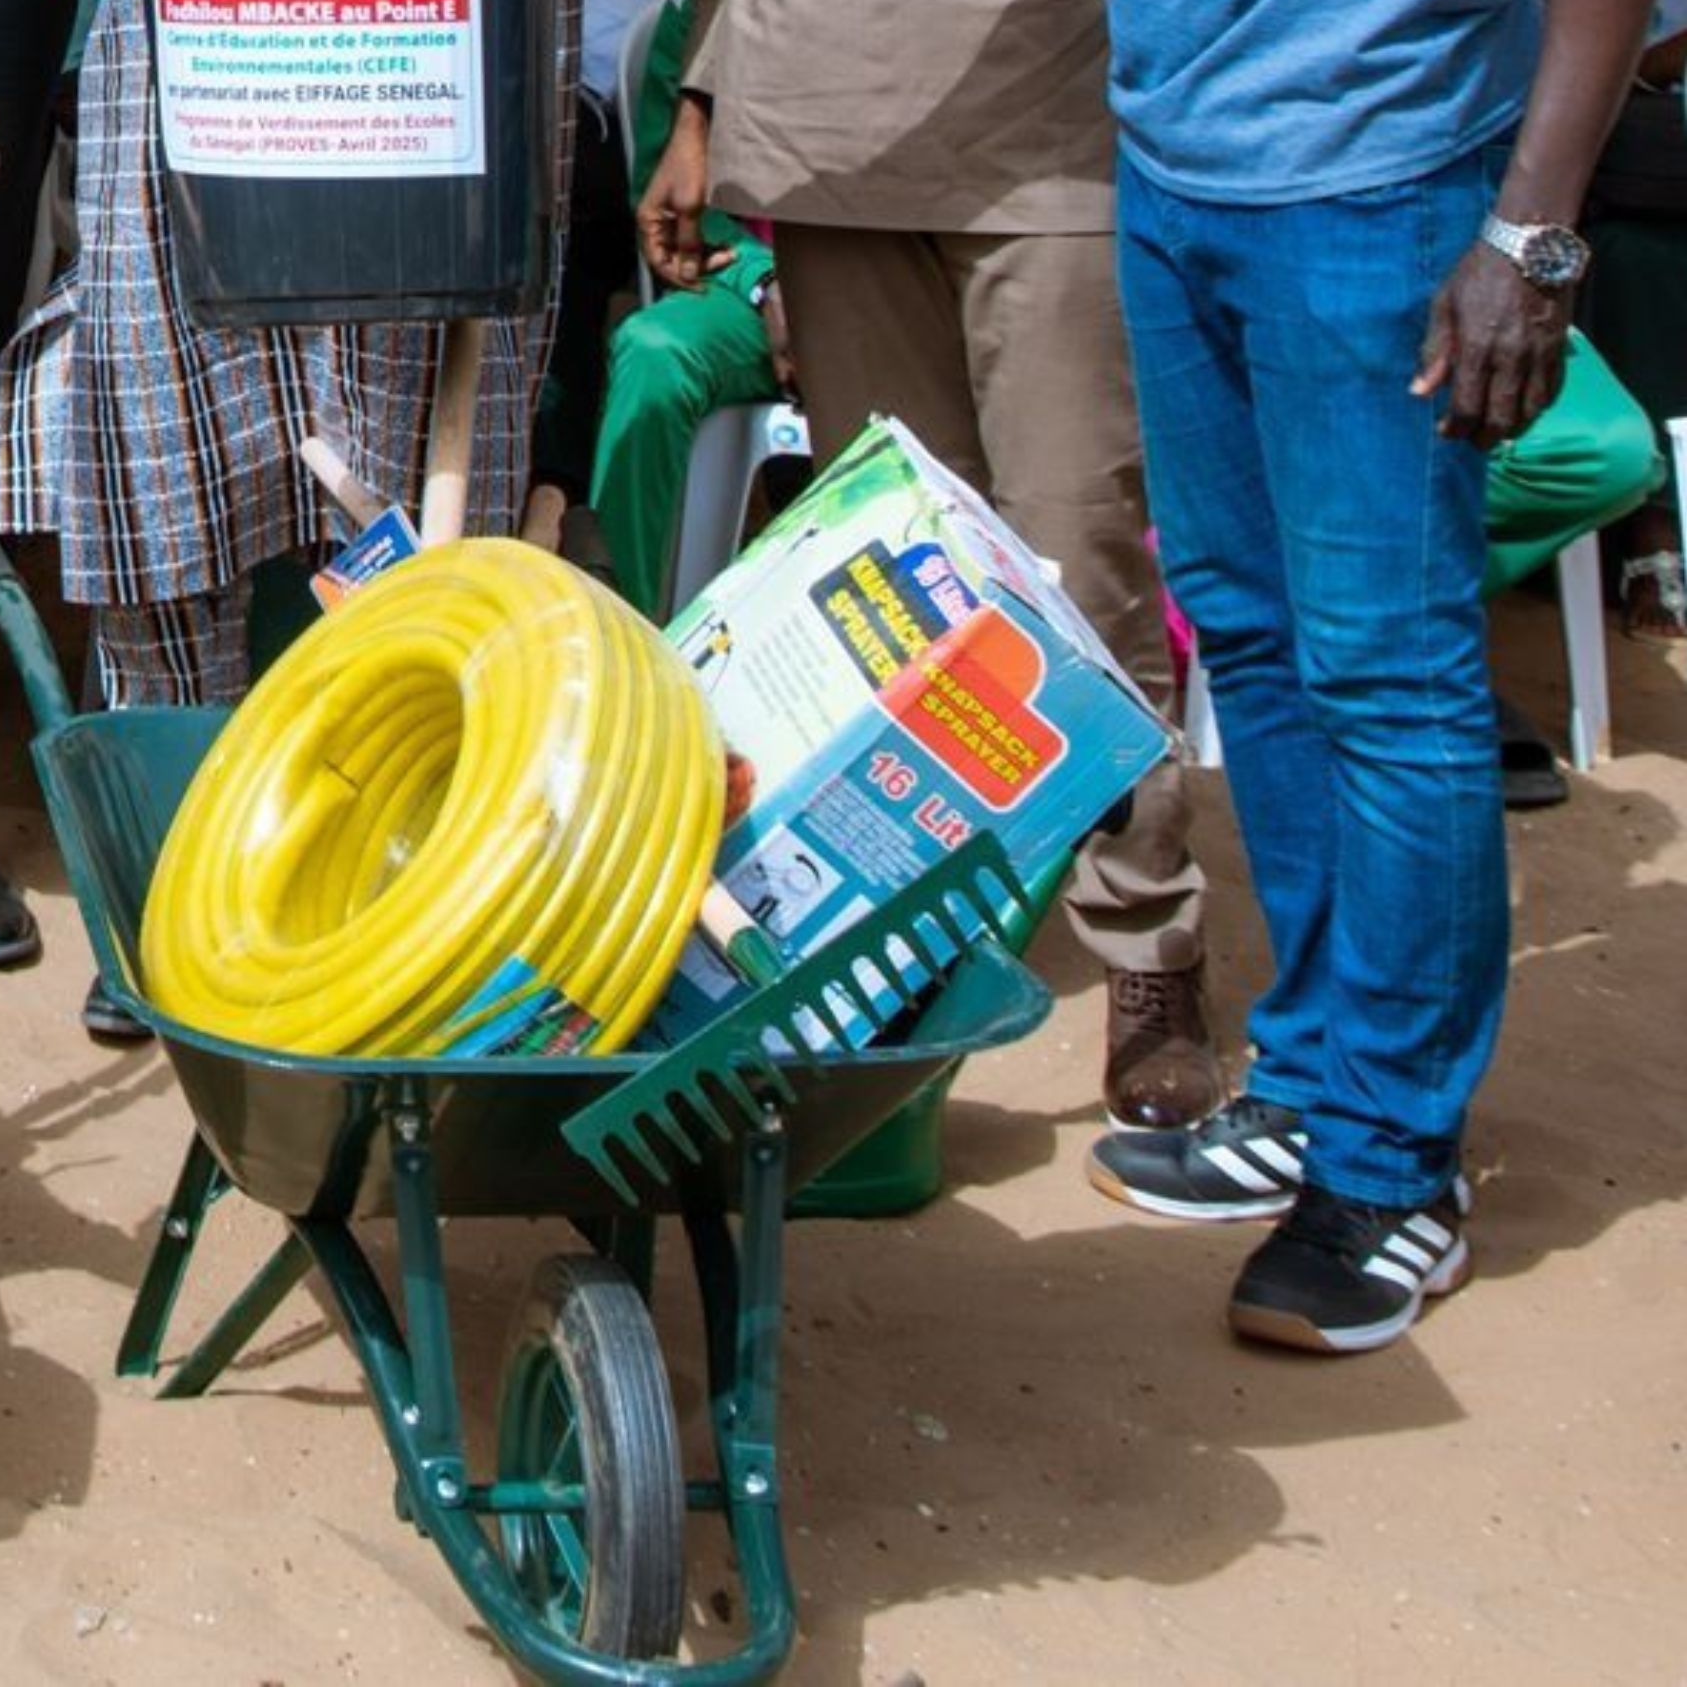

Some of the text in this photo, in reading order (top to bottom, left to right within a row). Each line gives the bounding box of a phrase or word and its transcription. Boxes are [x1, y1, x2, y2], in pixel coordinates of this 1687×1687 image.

[238, 0, 336, 22] MBACKE
[340, 4, 372, 22] au
[375, 0, 439, 21] Point
[332, 32, 357, 48] de
[295, 84, 372, 101] EIFFAGE
[916, 662, 1041, 770] KNAPSACK
[919, 691, 1023, 785] SPRAYER
[866, 751, 919, 801] 16
